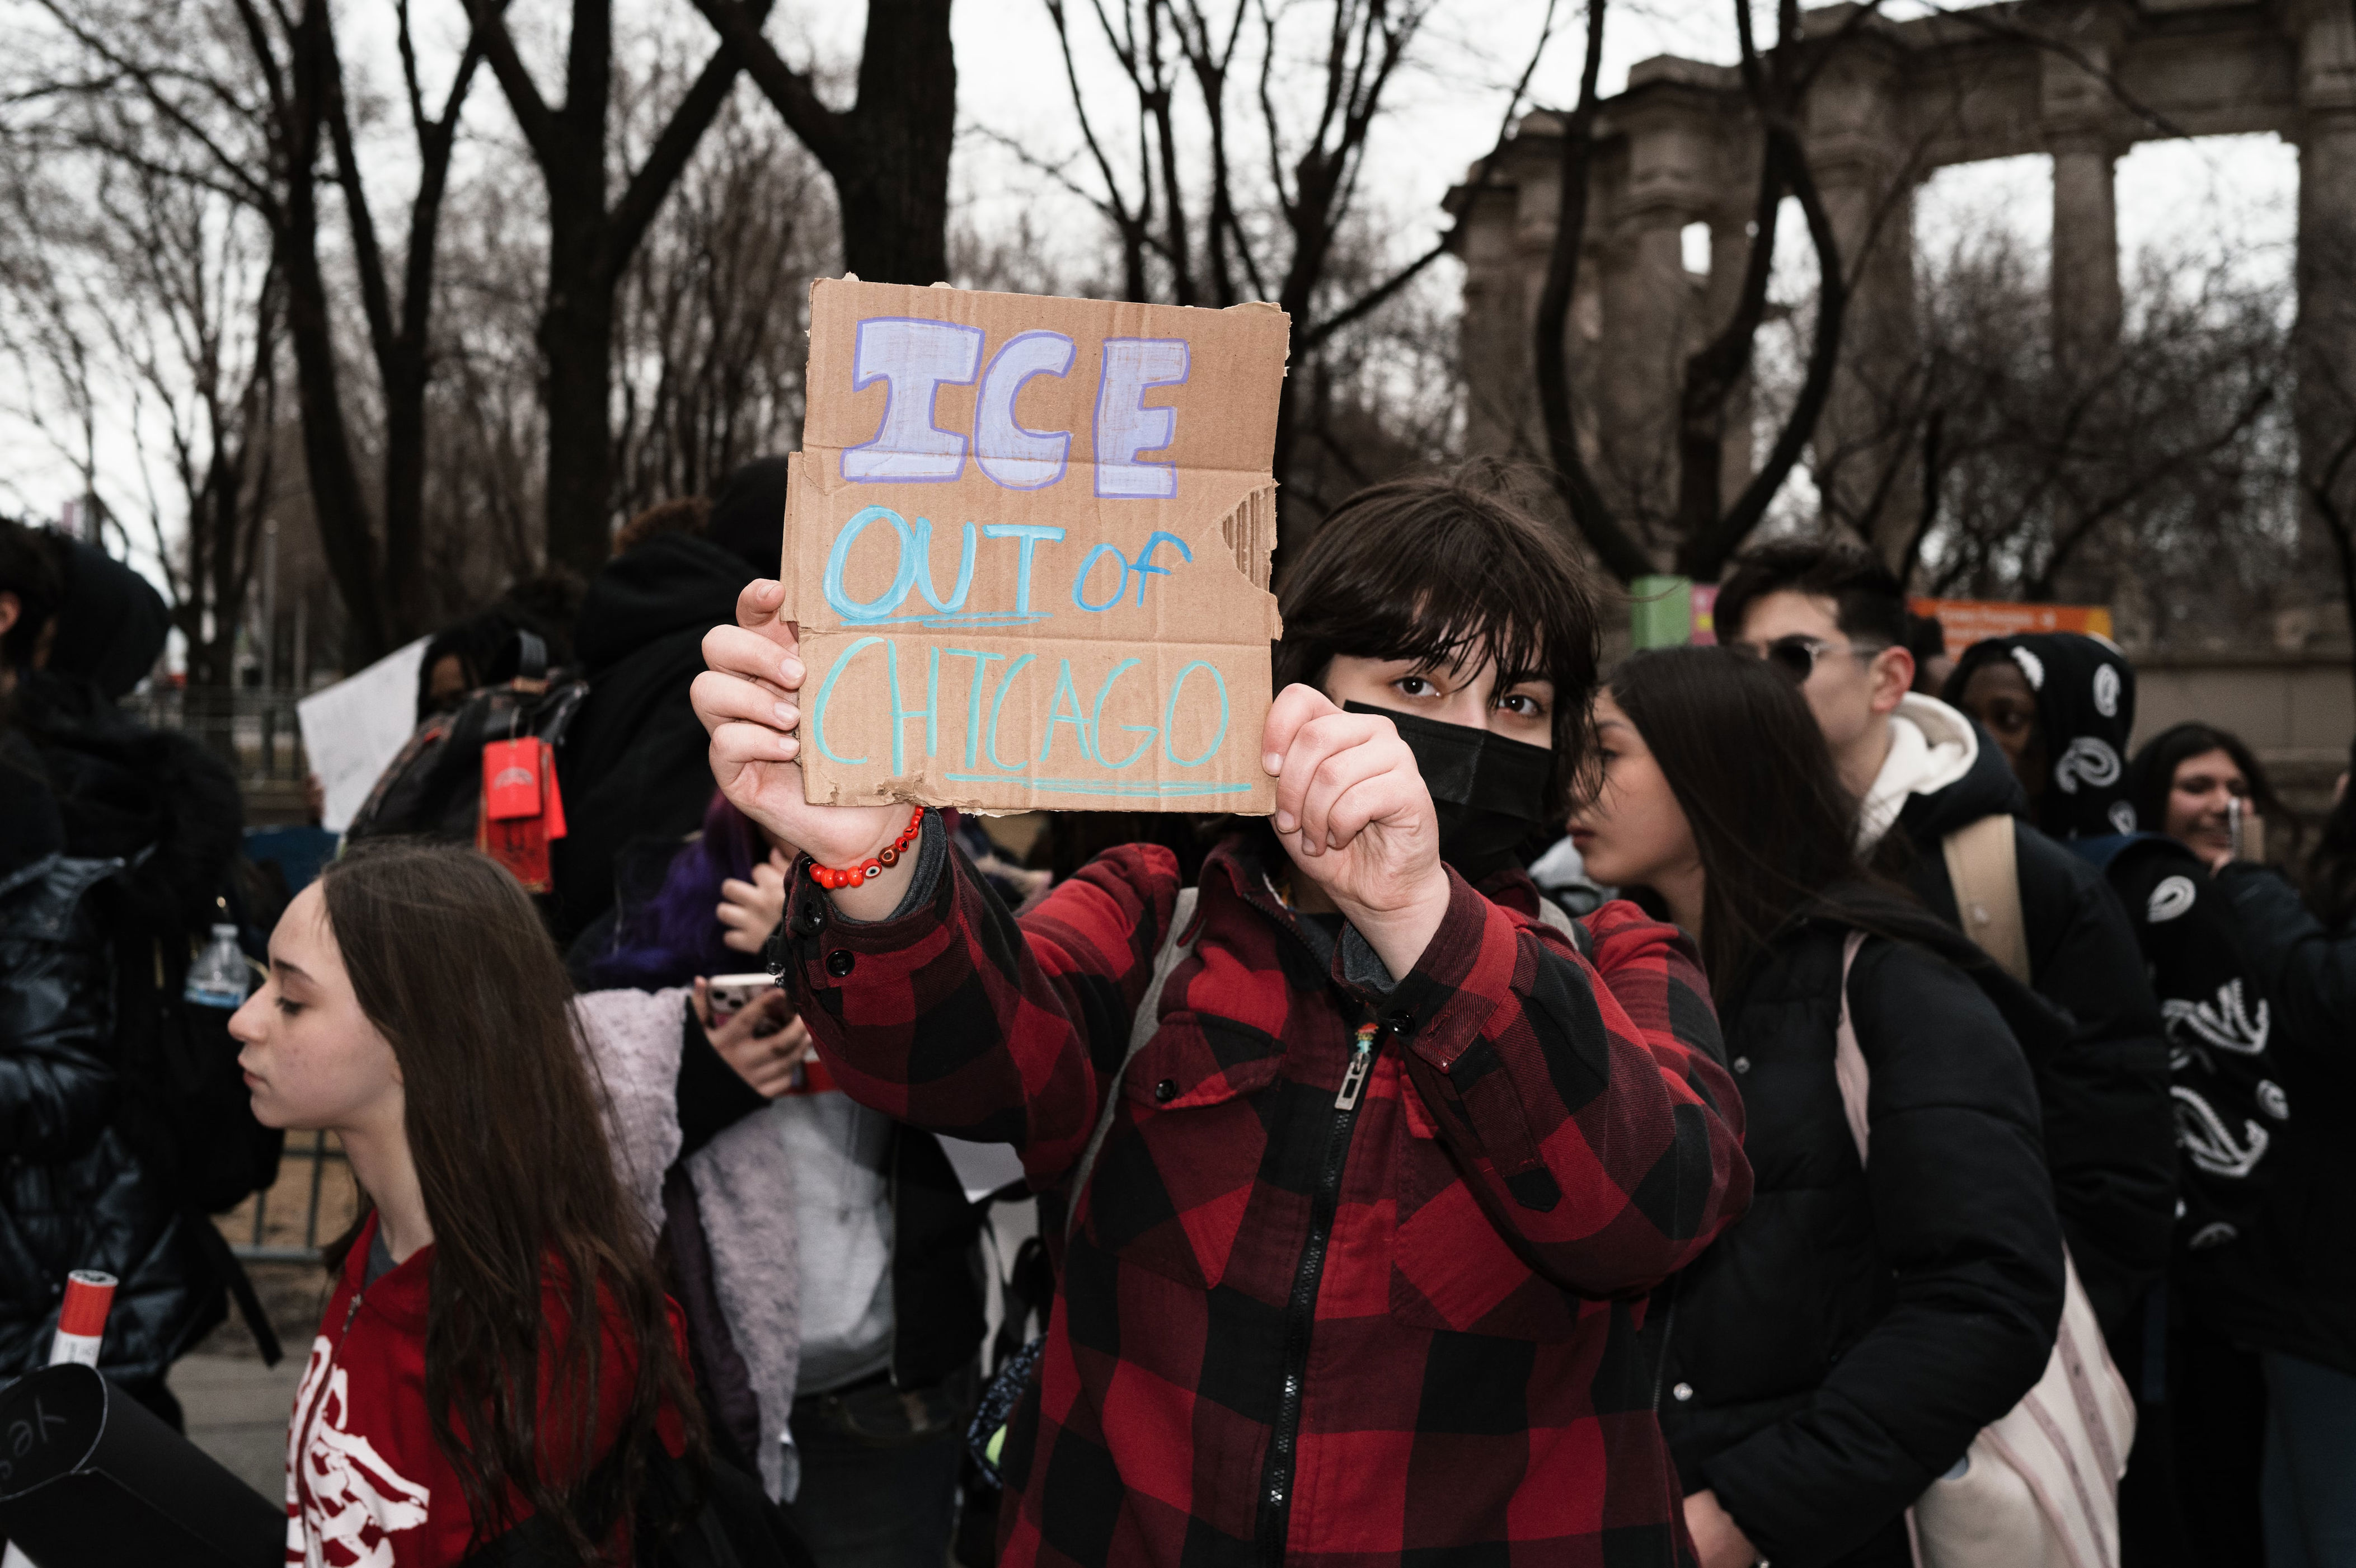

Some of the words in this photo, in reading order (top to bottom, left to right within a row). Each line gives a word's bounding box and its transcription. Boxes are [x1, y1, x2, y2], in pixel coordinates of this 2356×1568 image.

[839, 316, 1190, 499] ICE
[823, 504, 1067, 620] OUT
[813, 636, 1230, 776] CHICAGO
